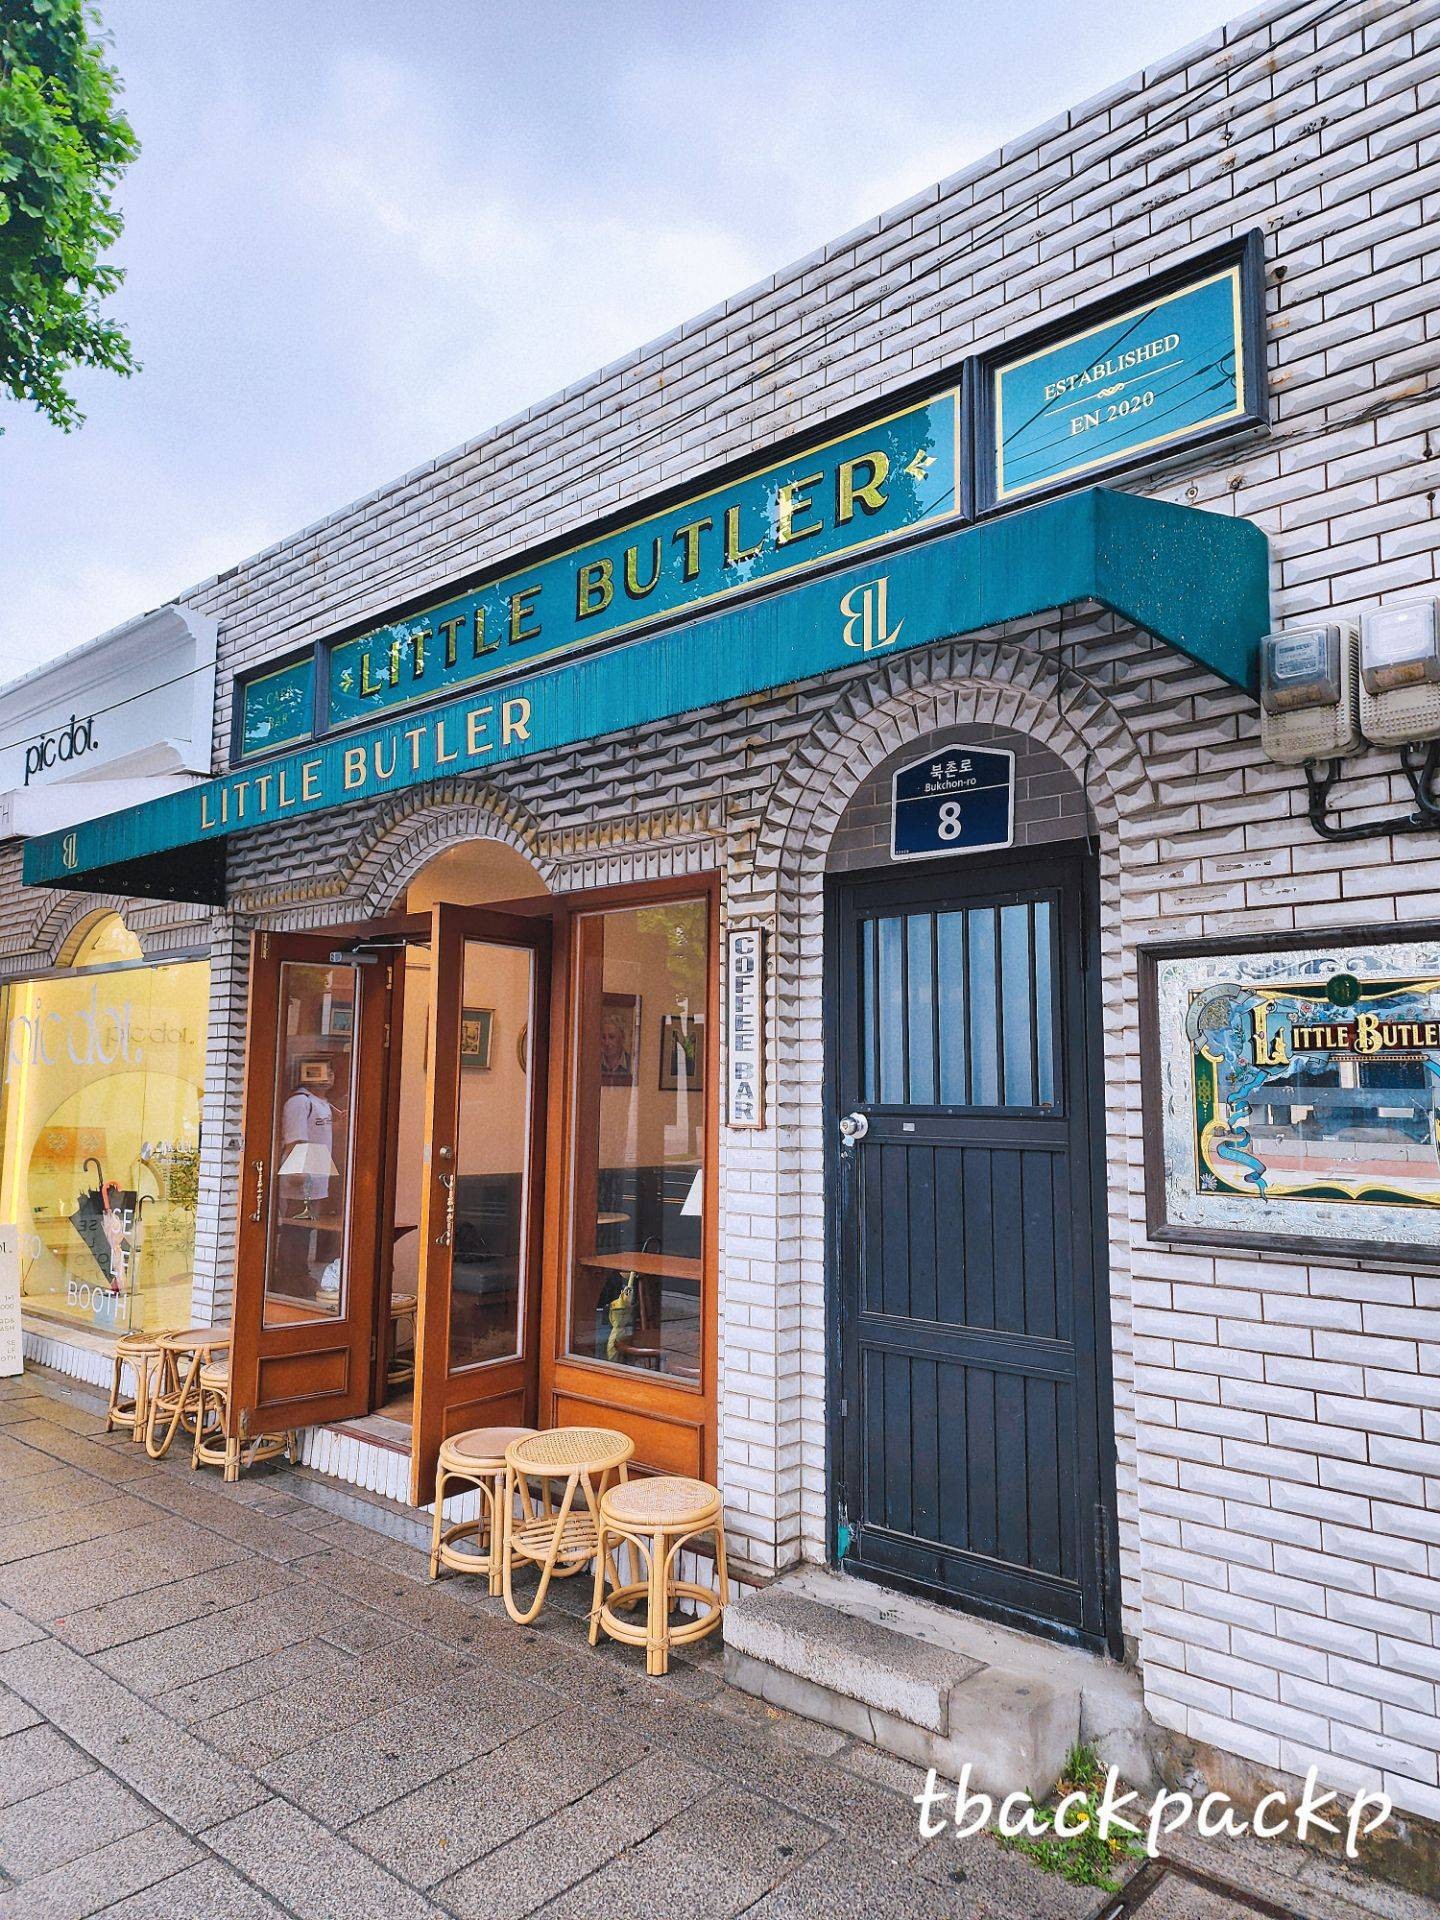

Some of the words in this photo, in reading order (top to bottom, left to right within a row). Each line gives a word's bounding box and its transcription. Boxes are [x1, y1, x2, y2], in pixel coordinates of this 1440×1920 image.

[1043, 333, 1181, 401] ESTABLISHED
[1070, 409, 1100, 435] EN
[1106, 391, 1155, 422] 2020
[360, 583, 543, 698] LITTLE
[575, 450, 890, 621] BUTLER
[201, 758, 323, 830] LITTLE
[343, 698, 532, 790] BUTLER
[924, 777, 978, 793] Bukchon-ro
[929, 758, 974, 781] 북촌로
[937, 801, 962, 841] 8
[734, 935, 755, 1052] COFFEE
[1252, 999, 1350, 1066] LITTLE
[1353, 1012, 1440, 1055] BUTLE
[734, 1061, 754, 1120] BAR
[112, 1208, 134, 1236] SE
[67, 1280, 128, 1321] BOOTH
